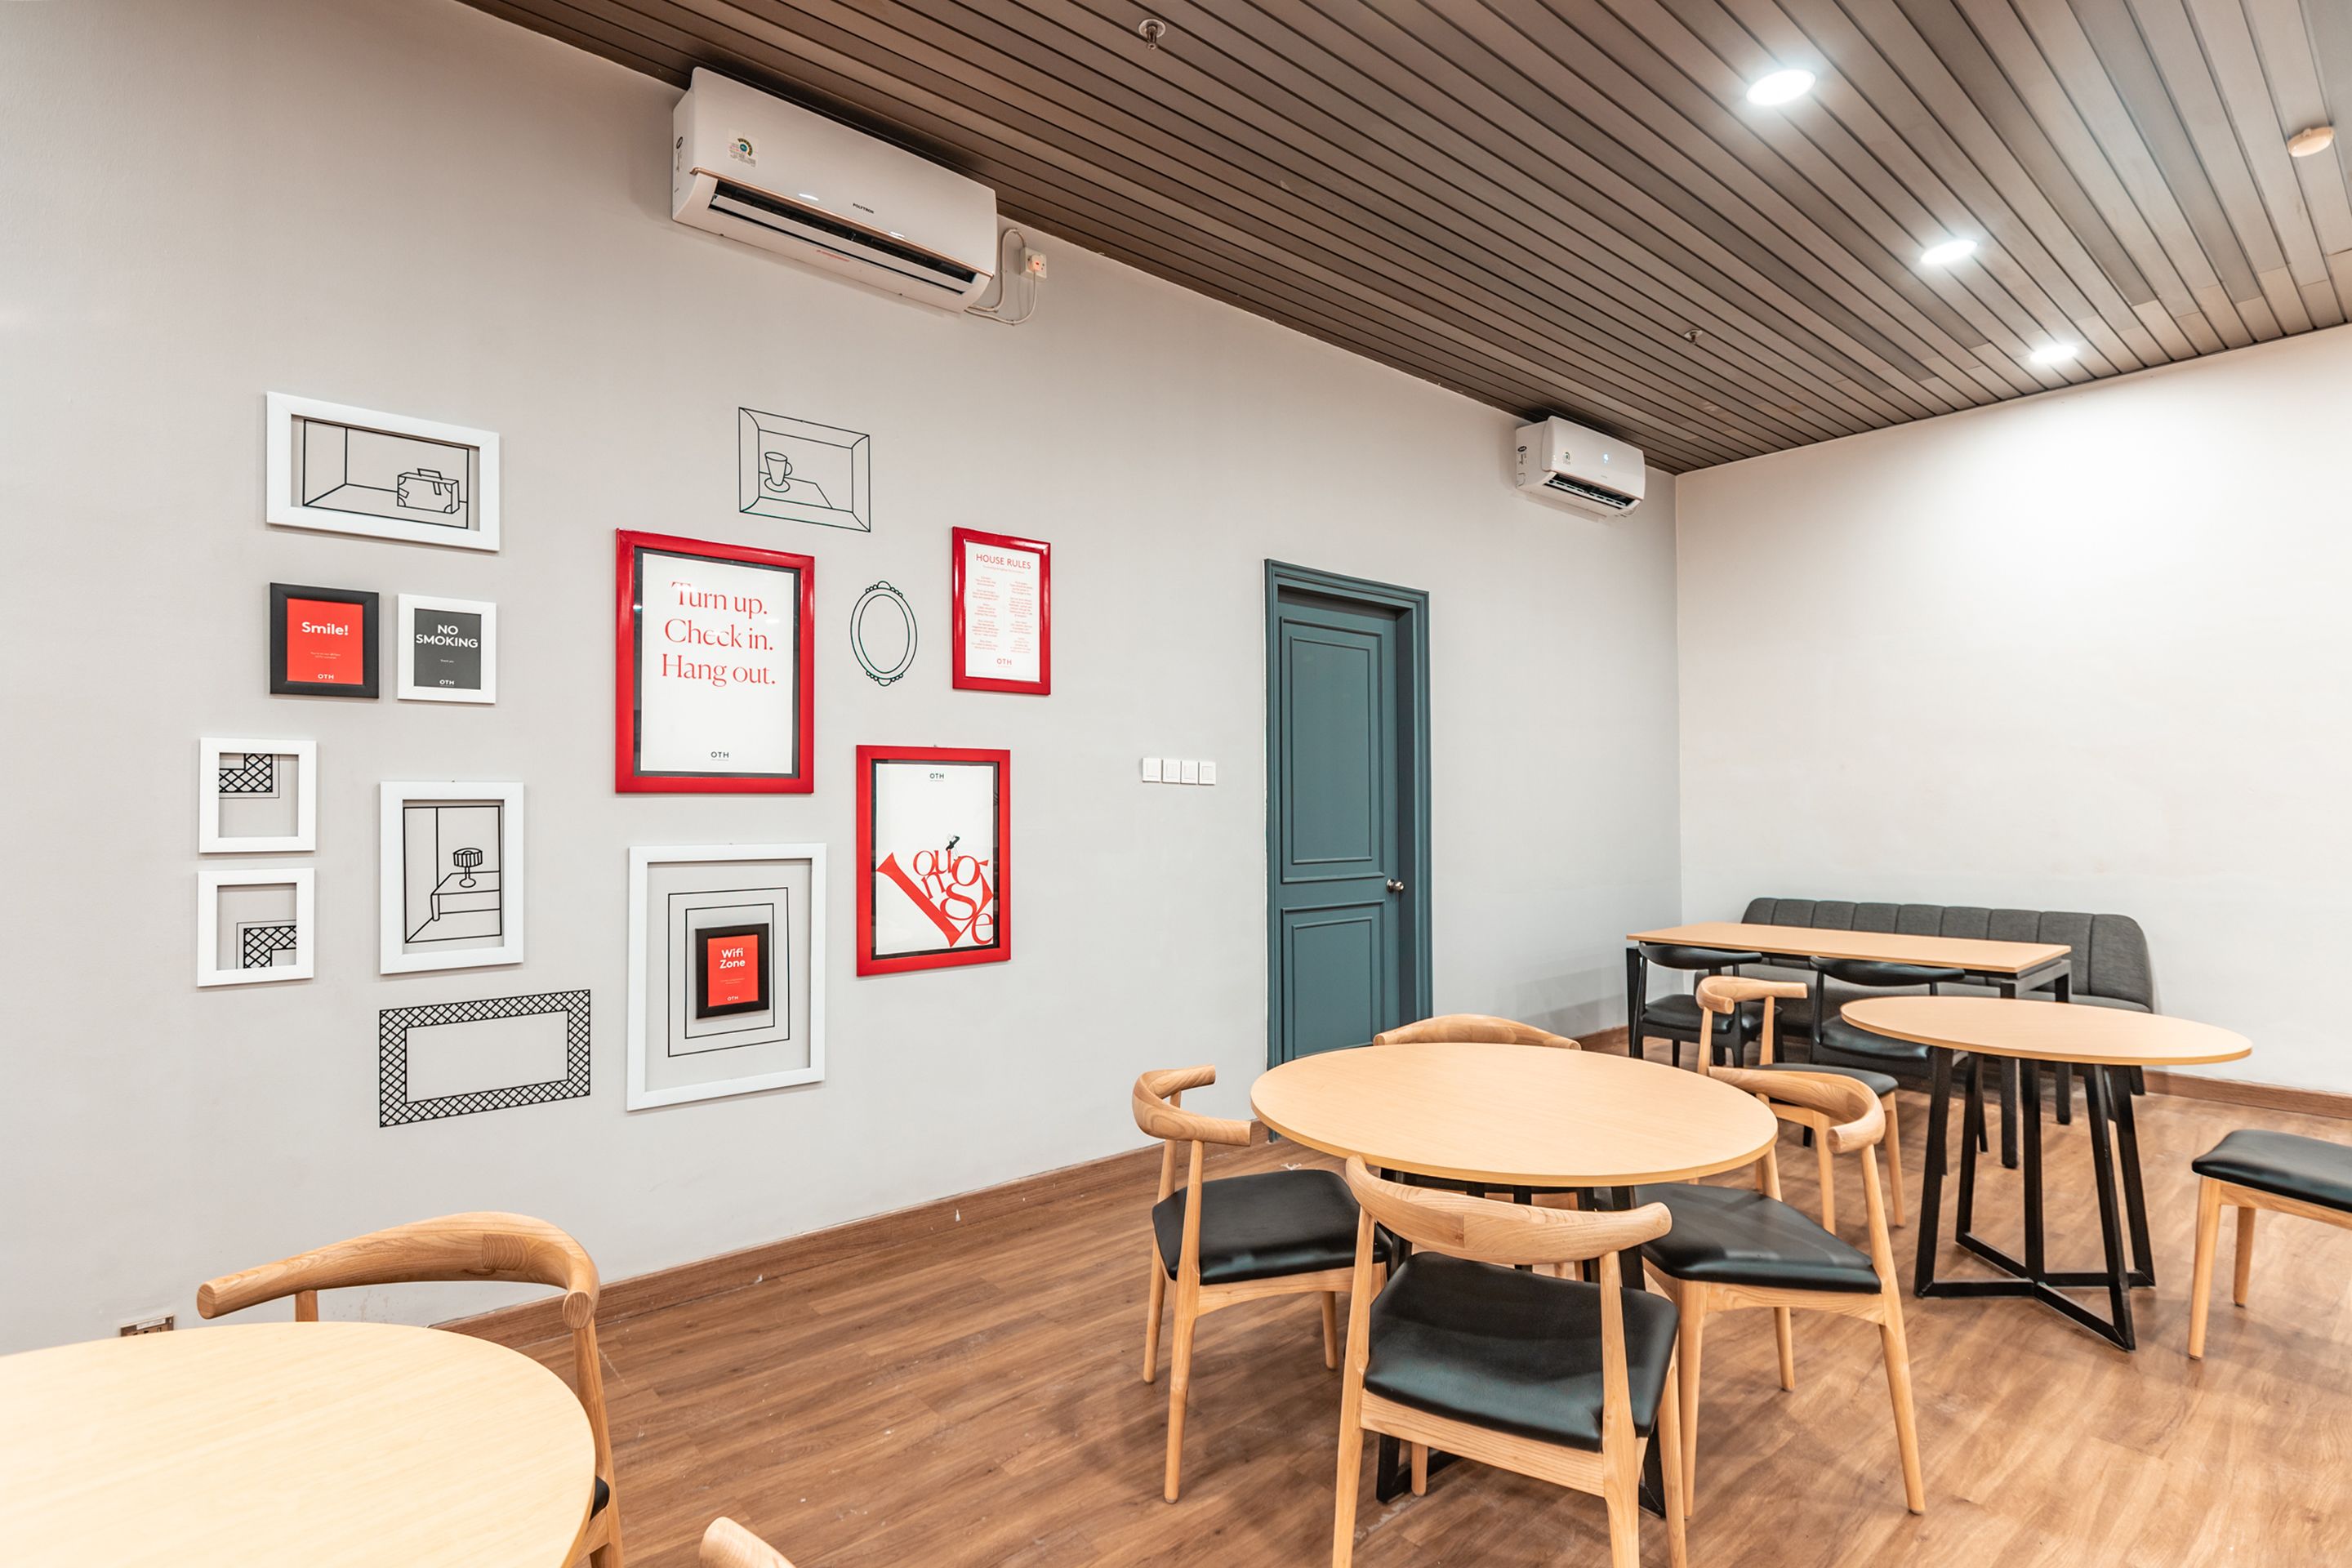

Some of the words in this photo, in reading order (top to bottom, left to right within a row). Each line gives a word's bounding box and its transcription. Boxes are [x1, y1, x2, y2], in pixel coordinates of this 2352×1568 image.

[976, 553, 1004, 565] HOUSE
[1007, 558, 1031, 569] RULES
[671, 581, 727, 610] Turn
[734, 596, 768, 619] up.
[301, 621, 350, 636] Smile!
[437, 624, 459, 635] NO
[664, 618, 742, 648] Check
[748, 627, 774, 651] in.
[415, 634, 479, 648] SMOKING
[996, 657, 1013, 666] OTH
[662, 653, 727, 688] Hang
[733, 666, 776, 685] out.
[710, 751, 729, 759] OTH
[722, 947, 743, 958] Wifi
[719, 960, 745, 969] Zone
